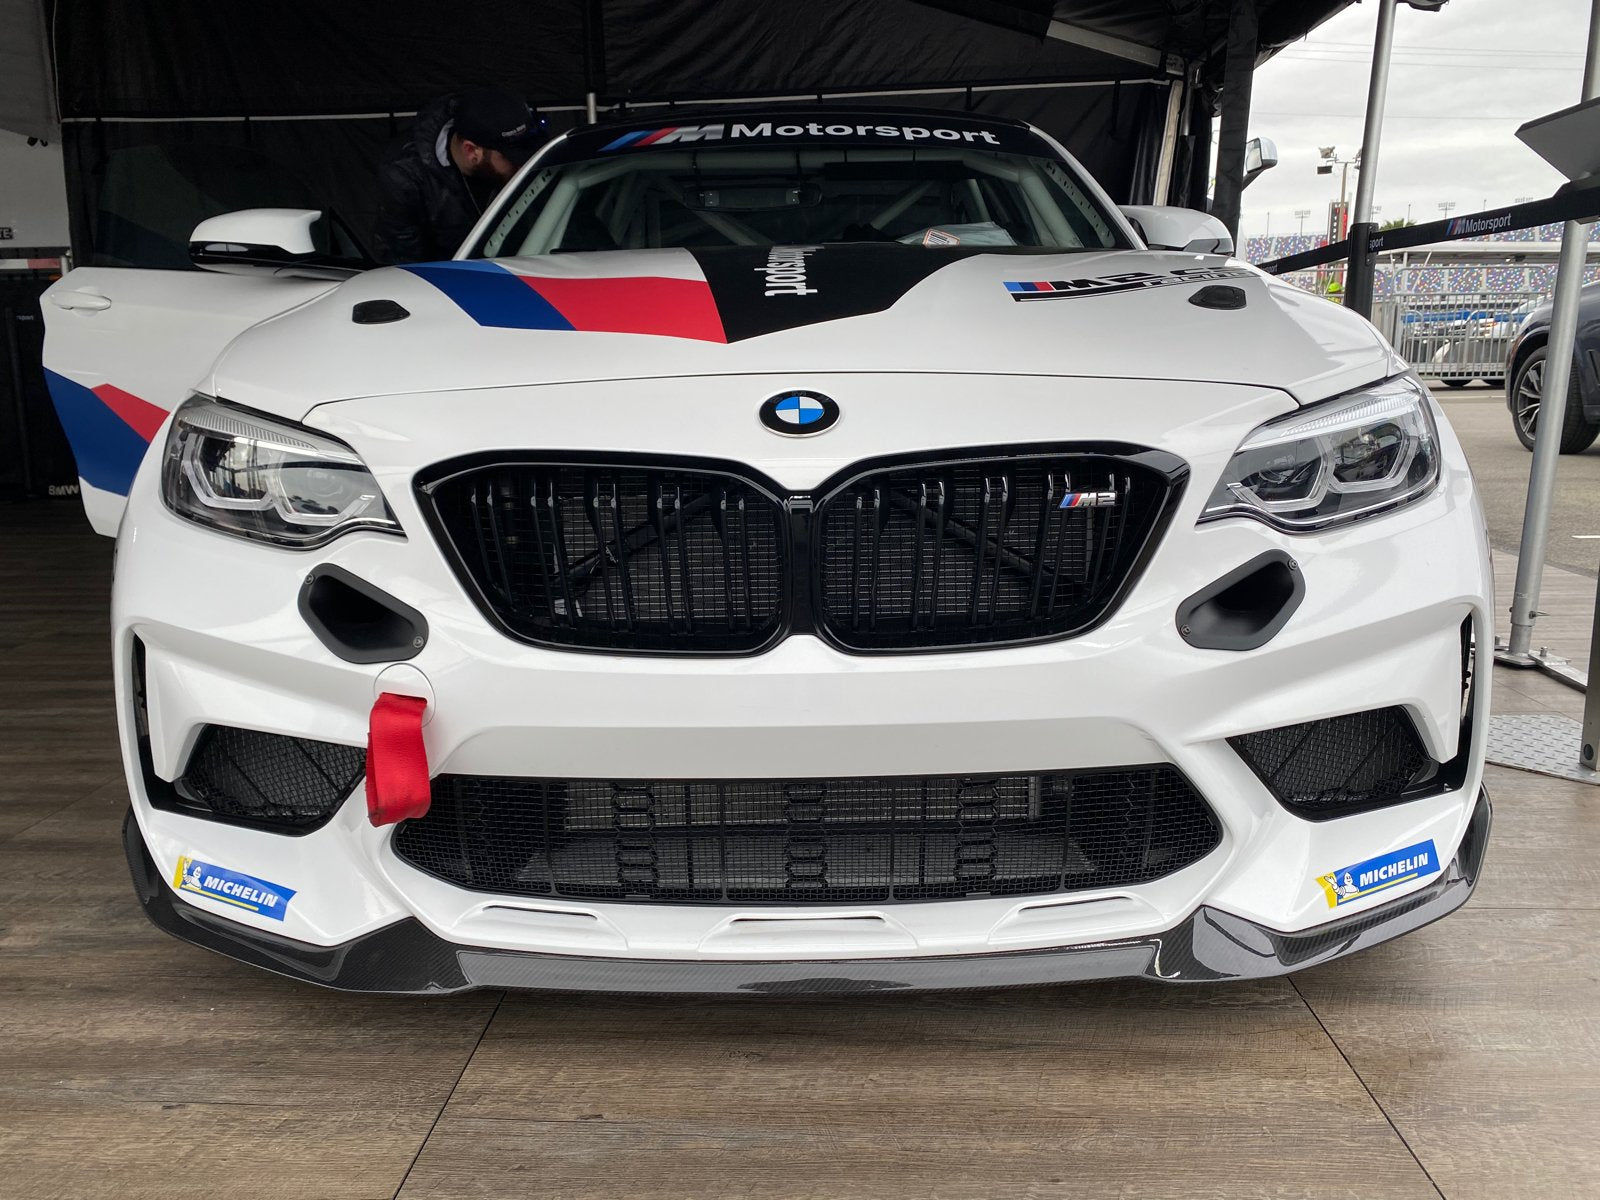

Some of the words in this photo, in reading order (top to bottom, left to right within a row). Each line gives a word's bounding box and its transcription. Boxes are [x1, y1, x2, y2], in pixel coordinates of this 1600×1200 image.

[731, 122, 1000, 145] Motorsport
[1465, 213, 1512, 233] Motorsport
[49, 485, 80, 496] BMW
[1360, 853, 1428, 887] MICHELIN
[204, 875, 278, 907] MICHELIN
